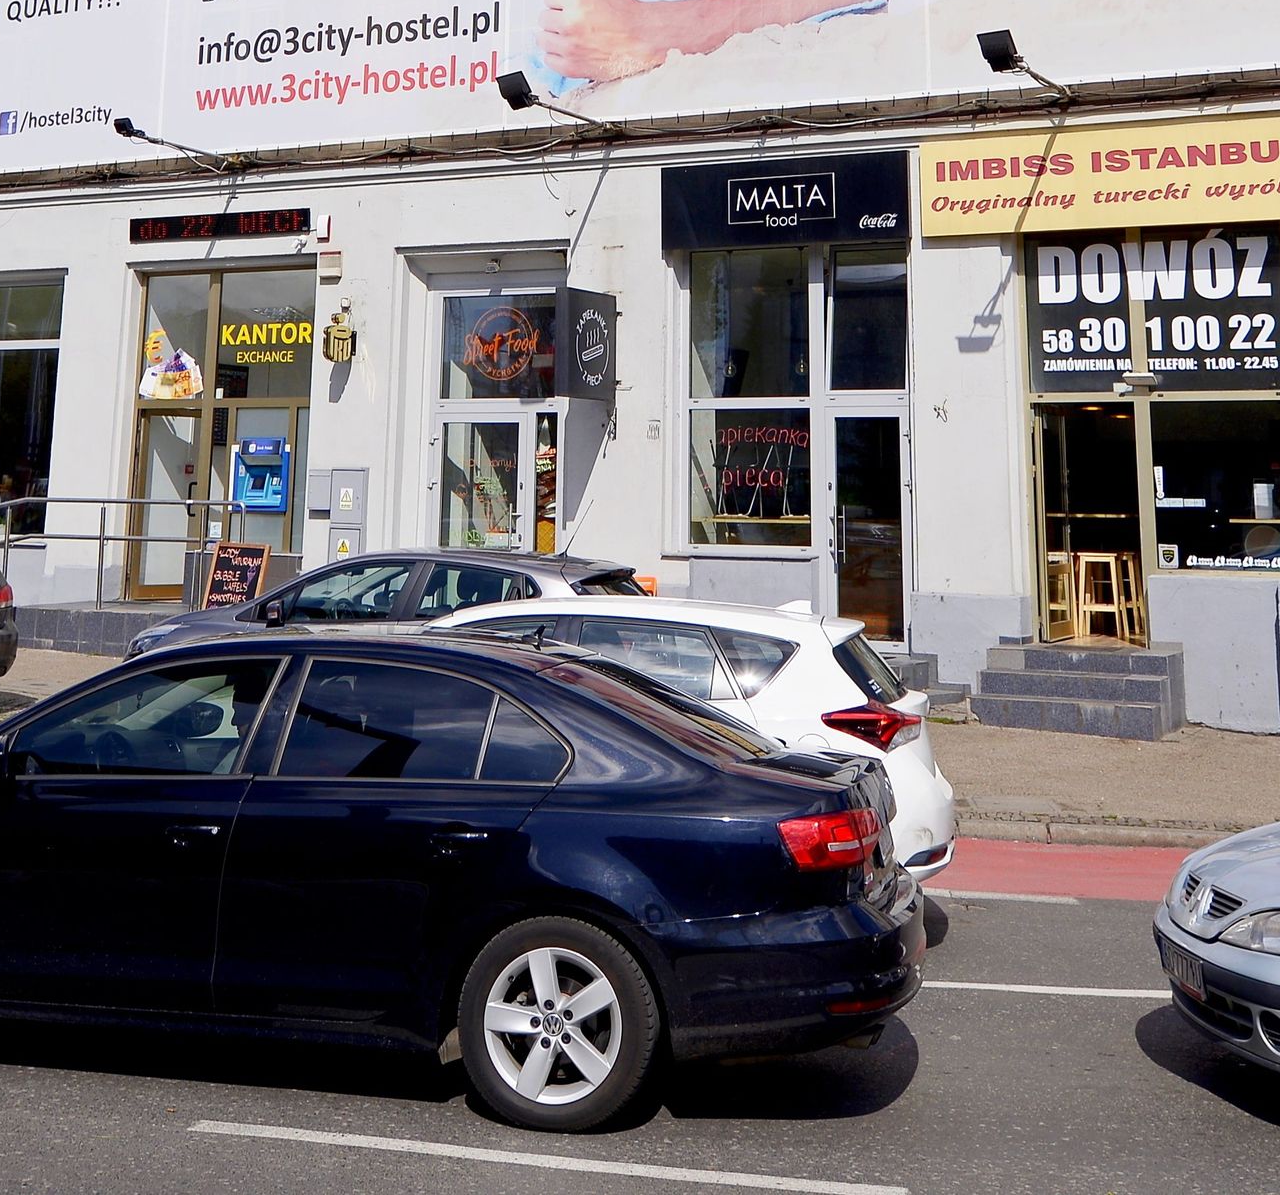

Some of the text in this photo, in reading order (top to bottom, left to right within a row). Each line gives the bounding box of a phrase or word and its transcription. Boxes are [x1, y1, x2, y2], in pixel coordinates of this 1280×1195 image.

[197, 1, 501, 66] info@3city-hostel.pl
[195, 51, 499, 112] www.3city-hostel.pl
[19, 105, 113, 134] /hostel3city
[935, 153, 1074, 182] IMBISS
[736, 183, 826, 212] MALTA
[931, 190, 1075, 215] Oryginalny
[1094, 182, 1191, 204] turecki
[765, 213, 798, 227] food
[1038, 228, 1272, 304] DOWÓZ
[221, 322, 312, 347] KANTOR
[576, 309, 608, 338] ZAPIEKANKA
[1042, 329, 1074, 353] 58
[1171, 315, 1220, 351] 00
[1228, 314, 1277, 350] 22
[236, 350, 294, 364] EXCHANGE
[463, 329, 540, 365] Street Food
[1043, 357, 1115, 372] ZAMÓWIENIA
[1116, 359, 1133, 372] NA
[1148, 358, 1198, 371] TELEFON:
[1243, 356, 1279, 370] 22.45
[586, 373, 603, 386] PIECA
[722, 465, 783, 494] pieca
